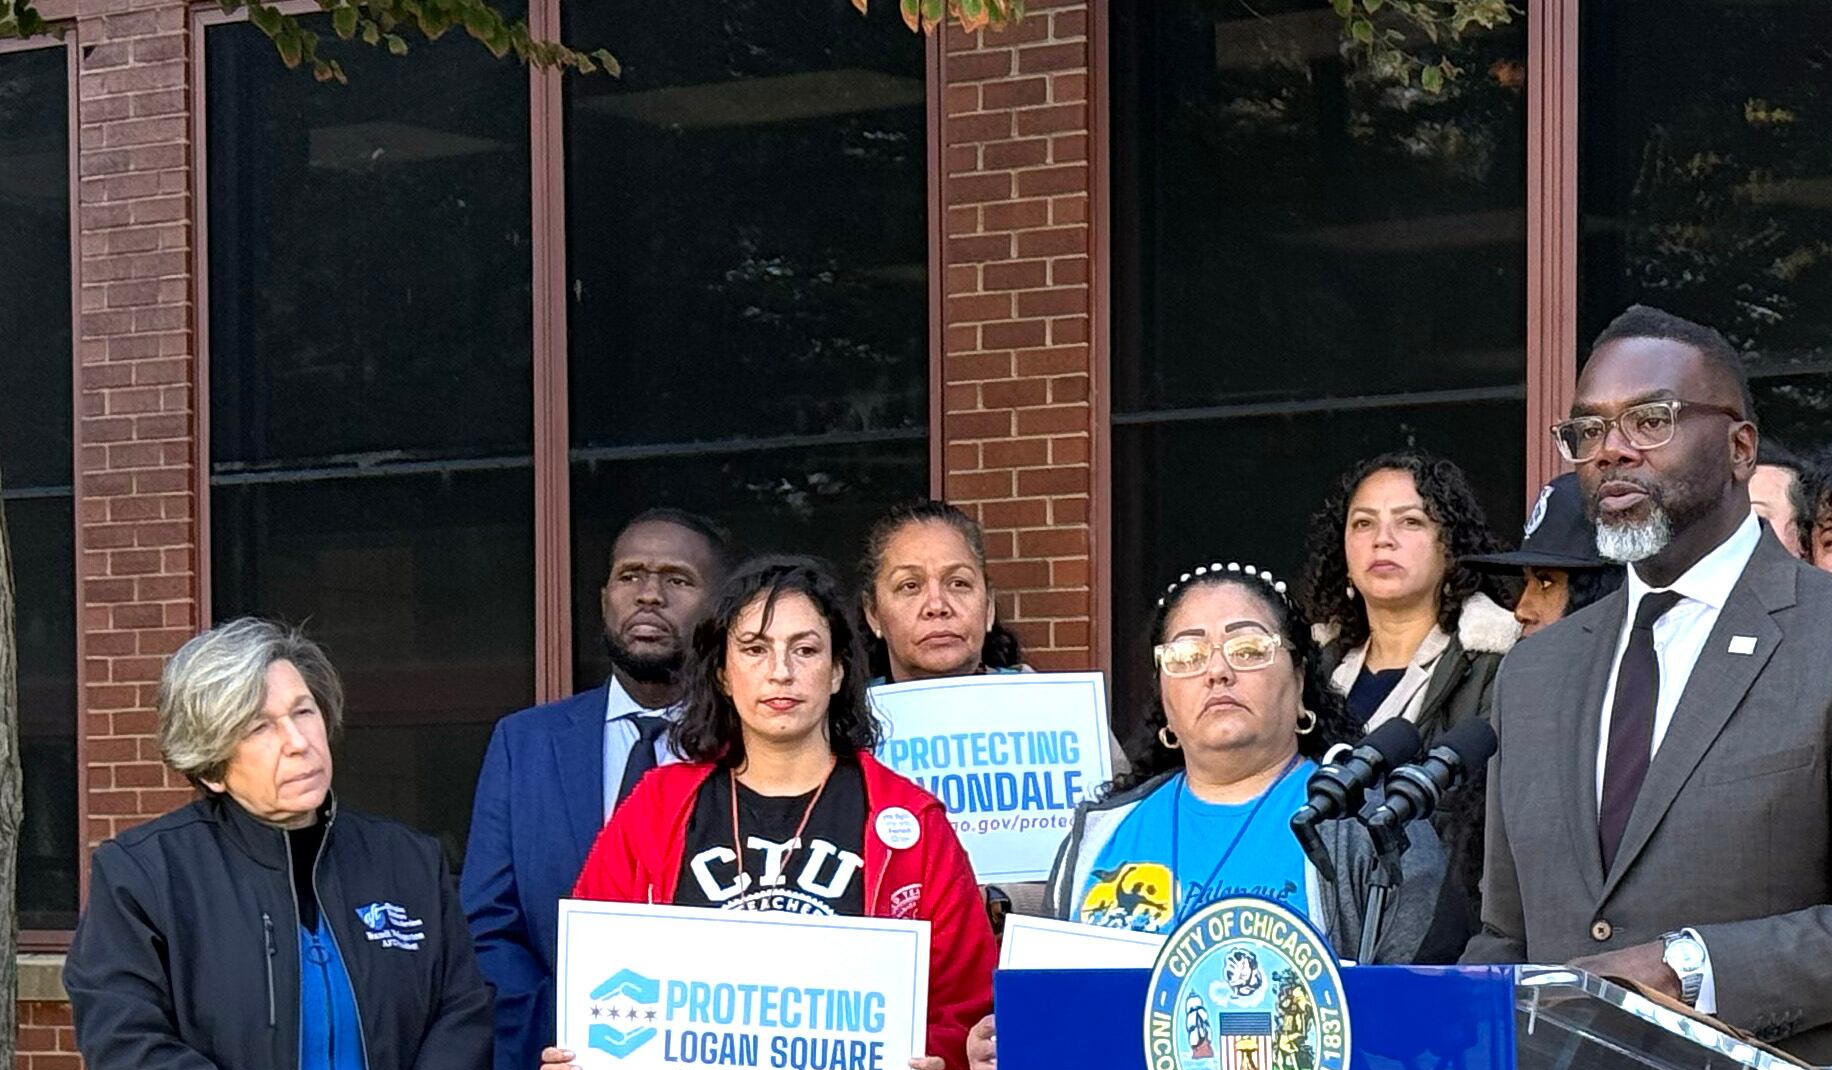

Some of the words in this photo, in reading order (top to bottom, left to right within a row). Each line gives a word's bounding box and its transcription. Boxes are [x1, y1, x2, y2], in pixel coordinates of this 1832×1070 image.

[889, 730, 1081, 772] PROTECTING
[915, 770, 1084, 815] VONDALE
[690, 836, 865, 902] CTU
[1168, 926, 1206, 978] CITY
[1208, 911, 1235, 942] OF
[1240, 911, 1323, 981] CHICAGO
[665, 979, 886, 1034] PROTECTING
[663, 1029, 759, 1067] LOGAN
[1320, 1007, 1343, 1061] 1837
